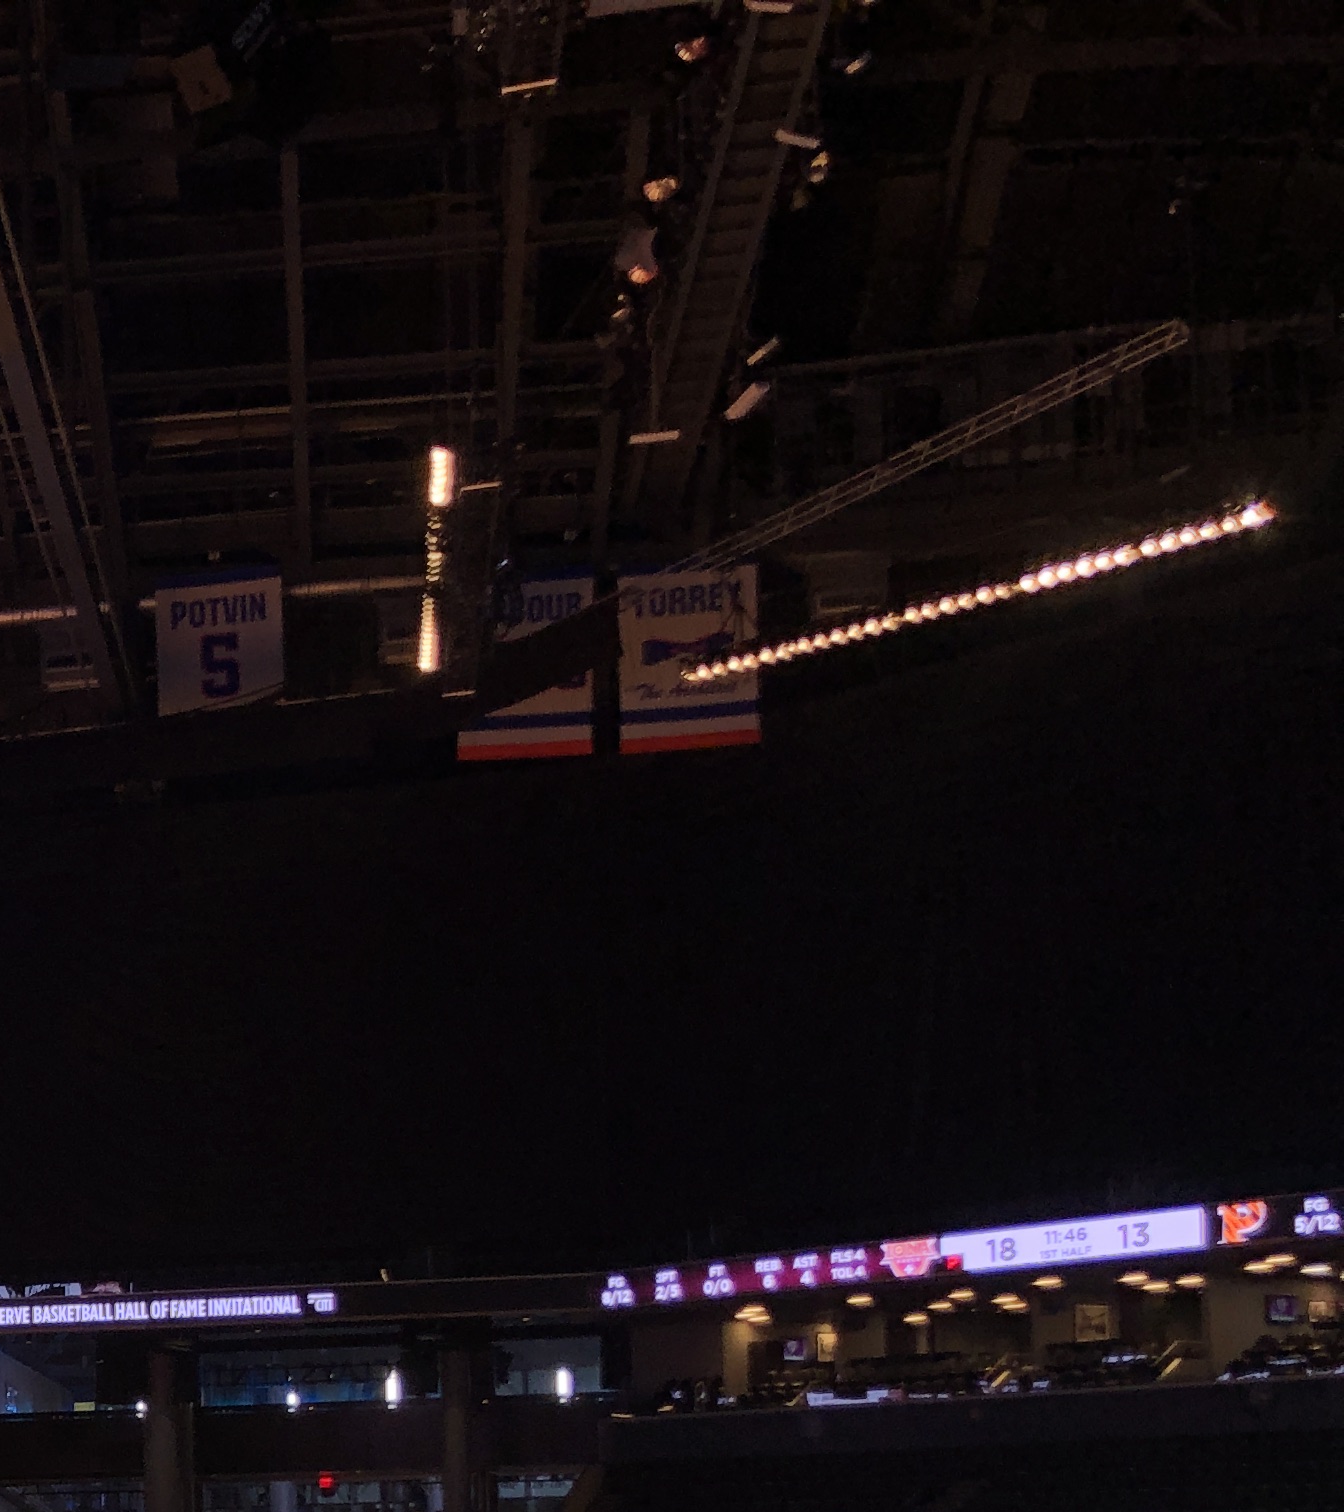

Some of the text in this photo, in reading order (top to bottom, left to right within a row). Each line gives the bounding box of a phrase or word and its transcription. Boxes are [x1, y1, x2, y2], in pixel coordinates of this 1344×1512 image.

[170, 592, 269, 631] POTVIN
[200, 633, 241, 698] 5
[1043, 1227, 1088, 1246] 11:46
[1116, 1221, 1151, 1249] 13
[1294, 1212, 1341, 1235] 5/12
[985, 1237, 1018, 1263] 18
[32, 1303, 114, 1324] BASKETBALL
[114, 1301, 149, 1321] HALL
[150, 1300, 170, 1319] OF
[169, 1298, 207, 1318] FAME
[207, 1293, 301, 1317] INVITATIONAL
